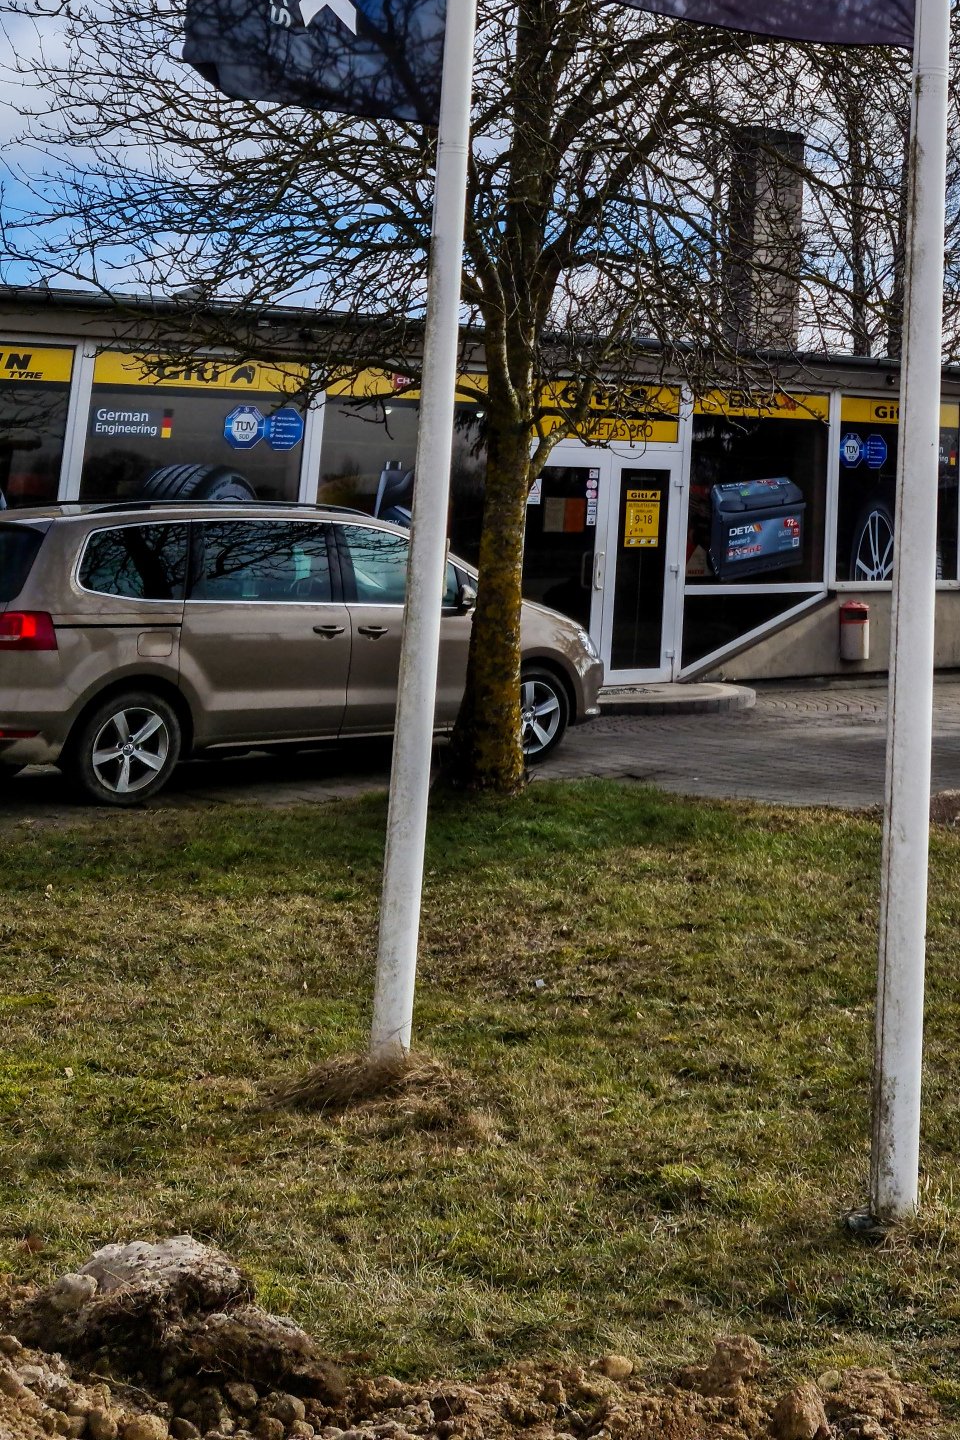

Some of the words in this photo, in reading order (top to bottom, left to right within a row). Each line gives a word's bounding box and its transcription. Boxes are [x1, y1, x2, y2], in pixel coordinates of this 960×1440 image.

[0, 353, 32, 370] N
[9, 371, 43, 379] TYRE
[97, 408, 149, 422] German
[95, 423, 157, 436] Engineering
[235, 420, 256, 431] TÜV
[634, 514, 653, 524] 9-18
[729, 525, 755, 537] DETA
